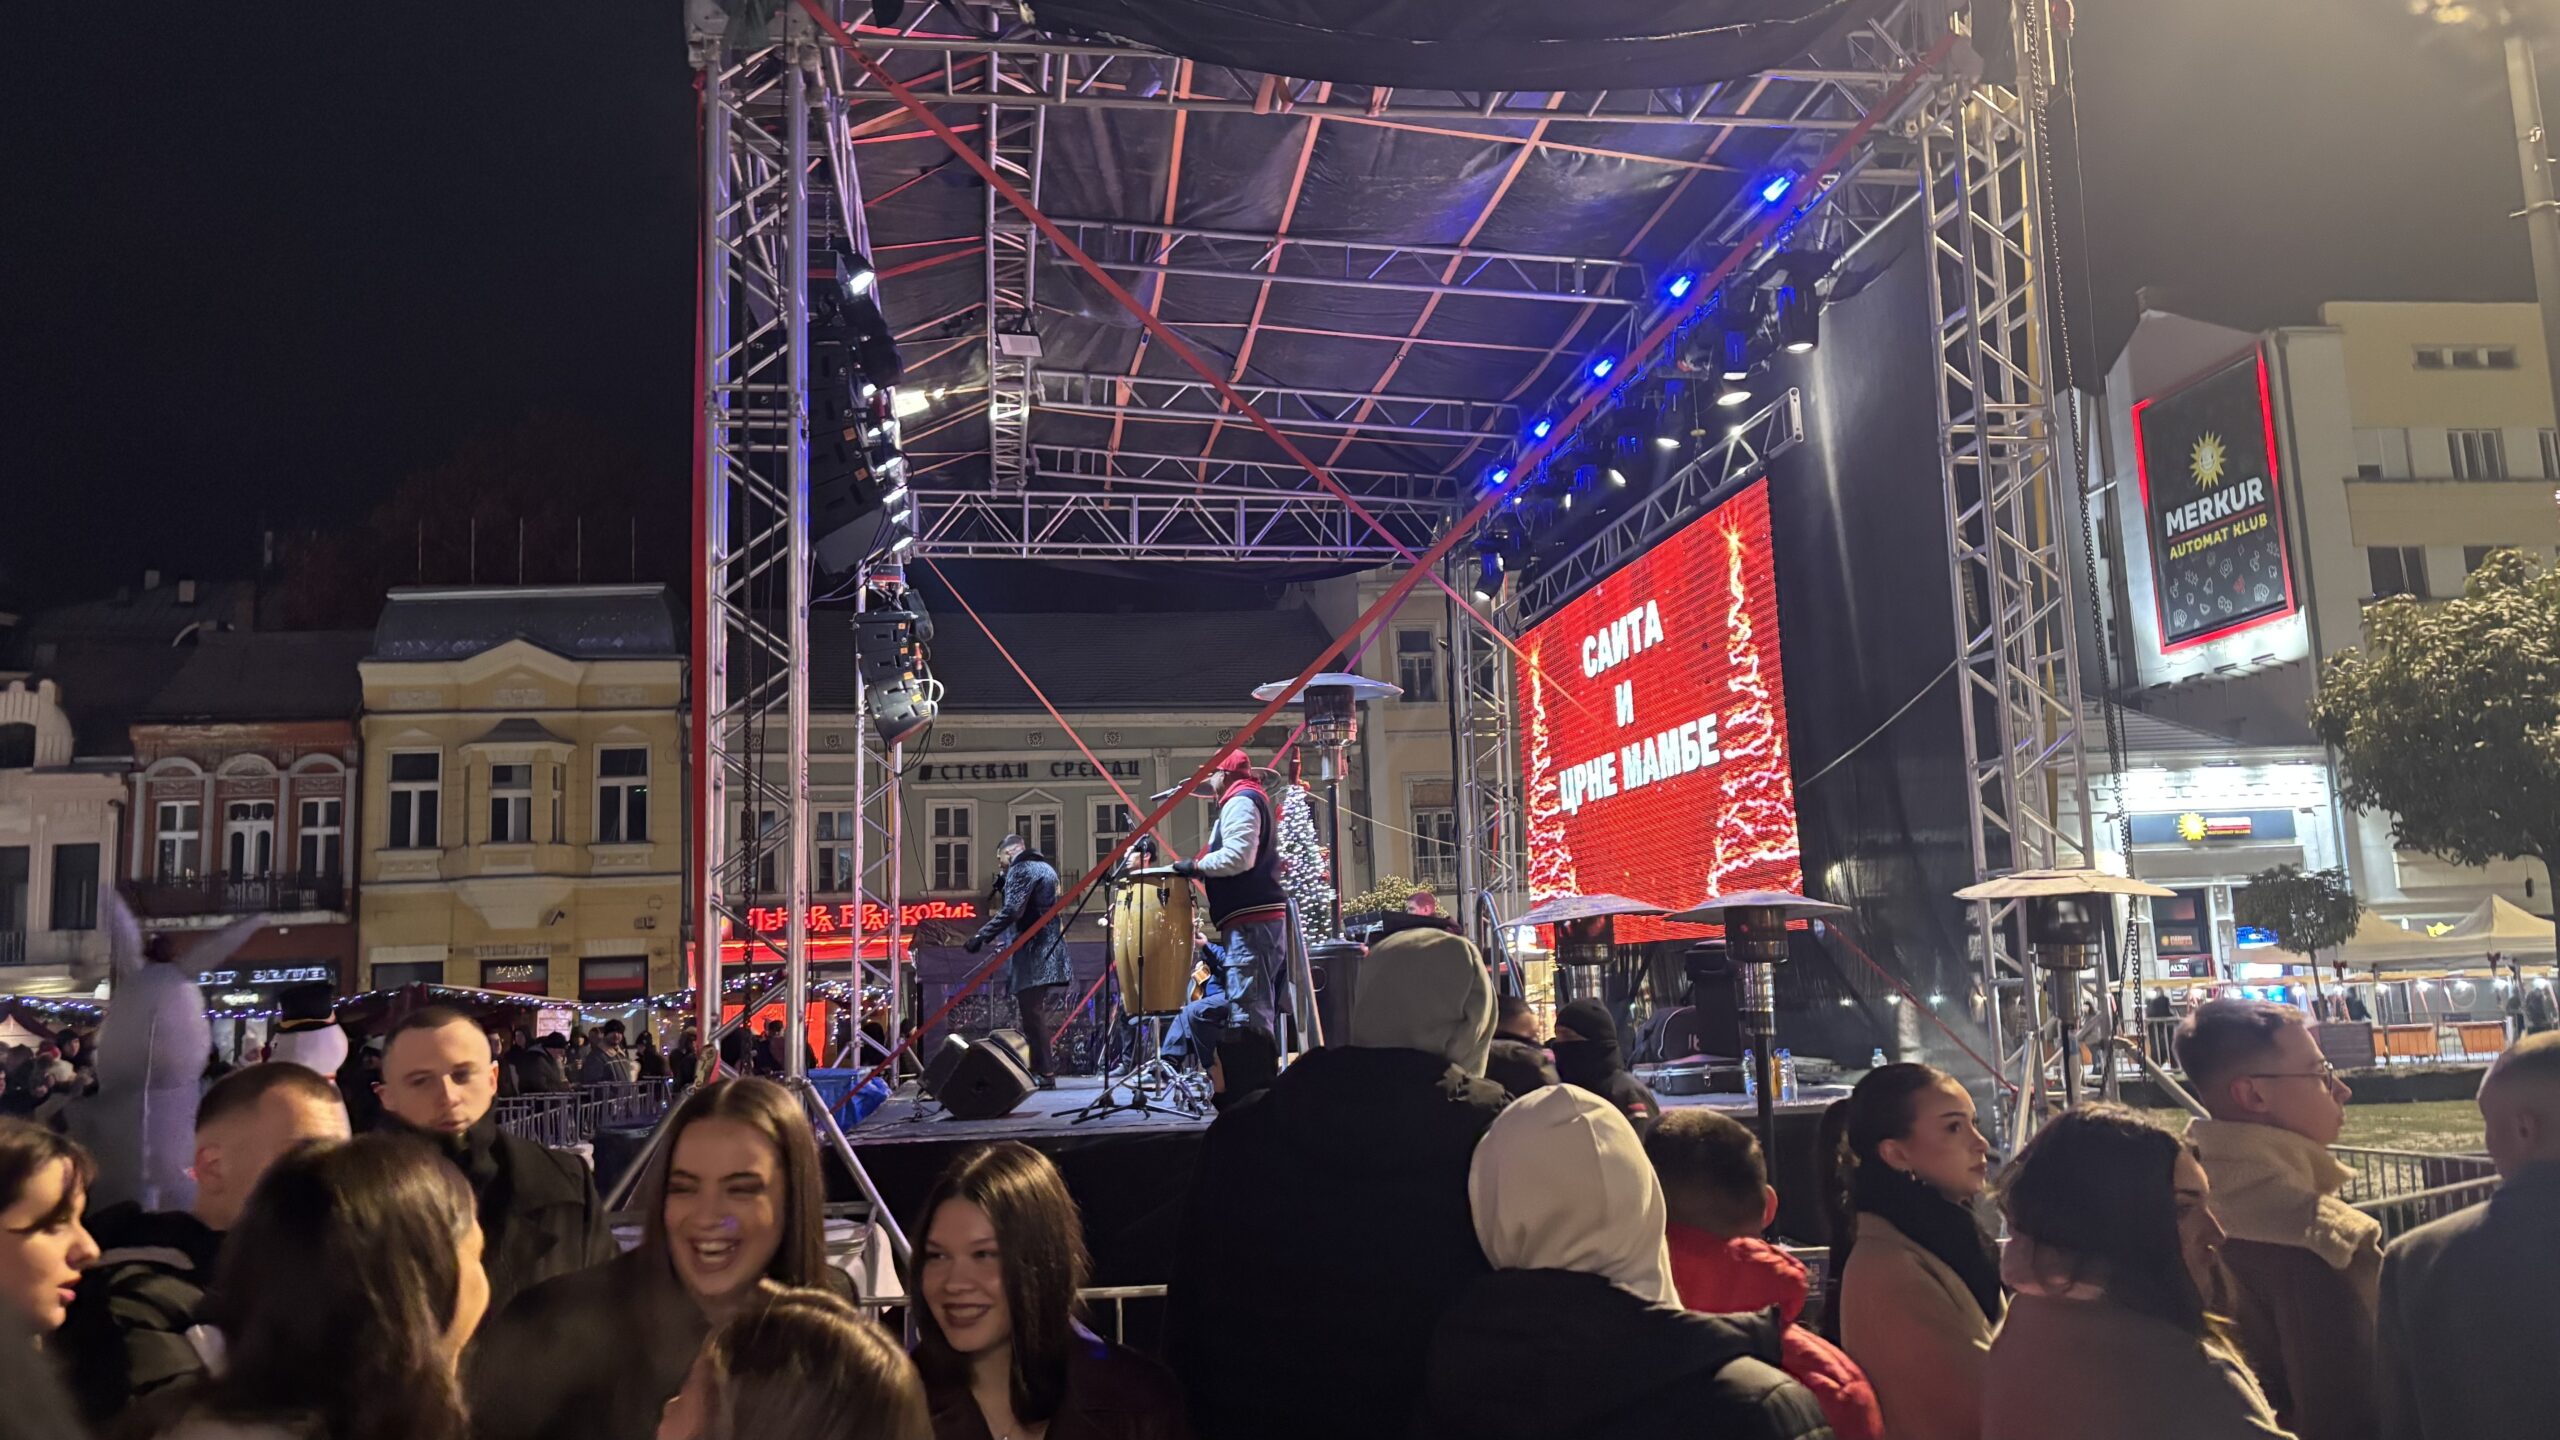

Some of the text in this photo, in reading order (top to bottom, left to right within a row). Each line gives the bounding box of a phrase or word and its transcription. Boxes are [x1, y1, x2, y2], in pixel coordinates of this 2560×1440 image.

[2165, 477, 2265, 537] MERKUR
[2169, 512, 2268, 560] AUTOMAT KLUB
[1582, 600, 1664, 678] САИТА
[1615, 679, 1634, 728] И
[941, 762, 1028, 780] СТЕВАН
[1559, 713, 1720, 815] ЦРНЕ МАМБЕ
[747, 905, 836, 932] ПЕКРА
